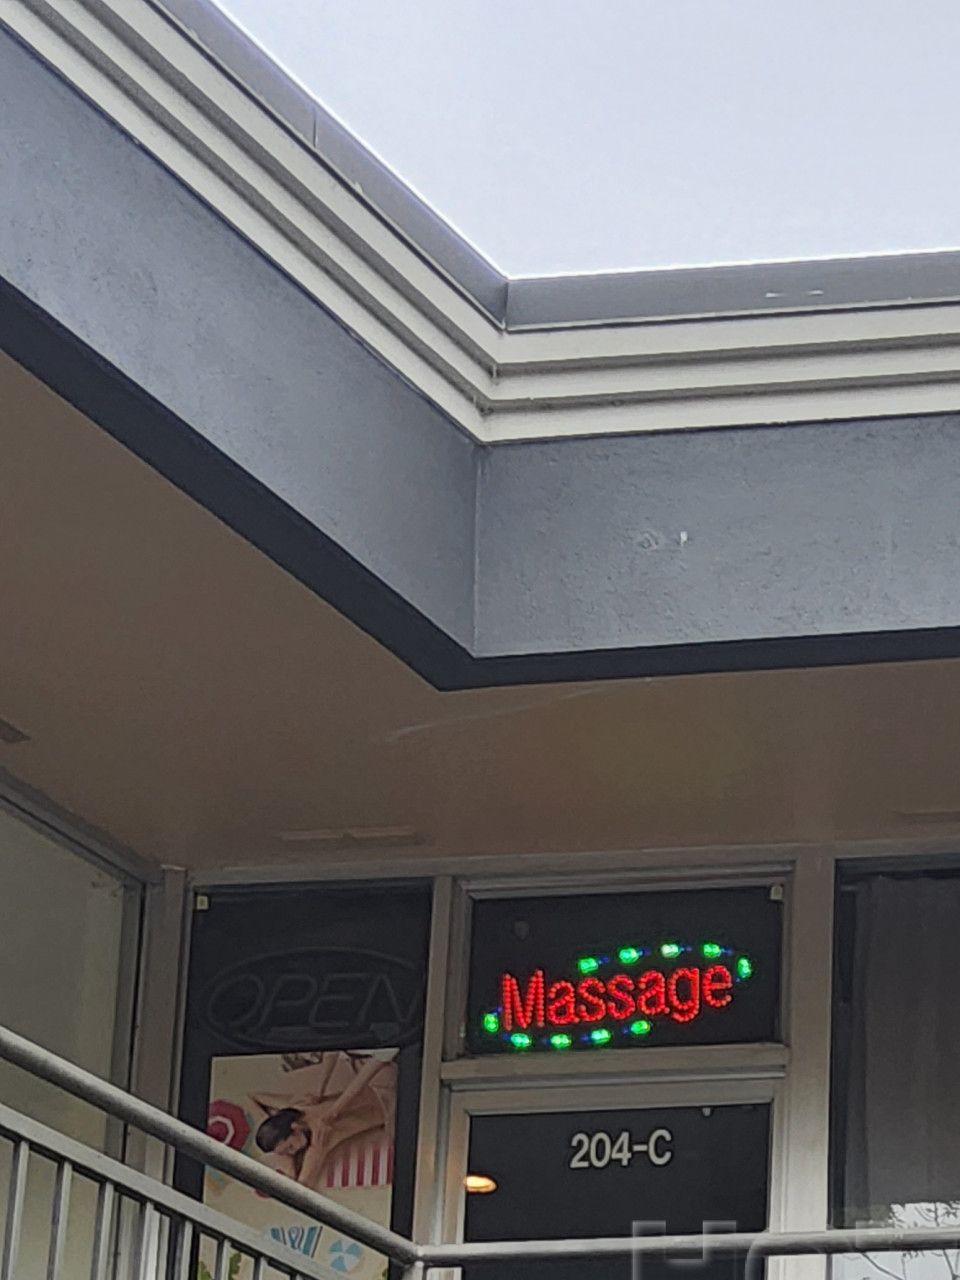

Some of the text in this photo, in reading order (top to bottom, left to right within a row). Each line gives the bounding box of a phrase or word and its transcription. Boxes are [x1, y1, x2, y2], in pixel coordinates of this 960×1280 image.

[207, 973, 420, 1028] OPEN
[501, 963, 735, 1031] Massage
[569, 1128, 673, 1169] 204-C
